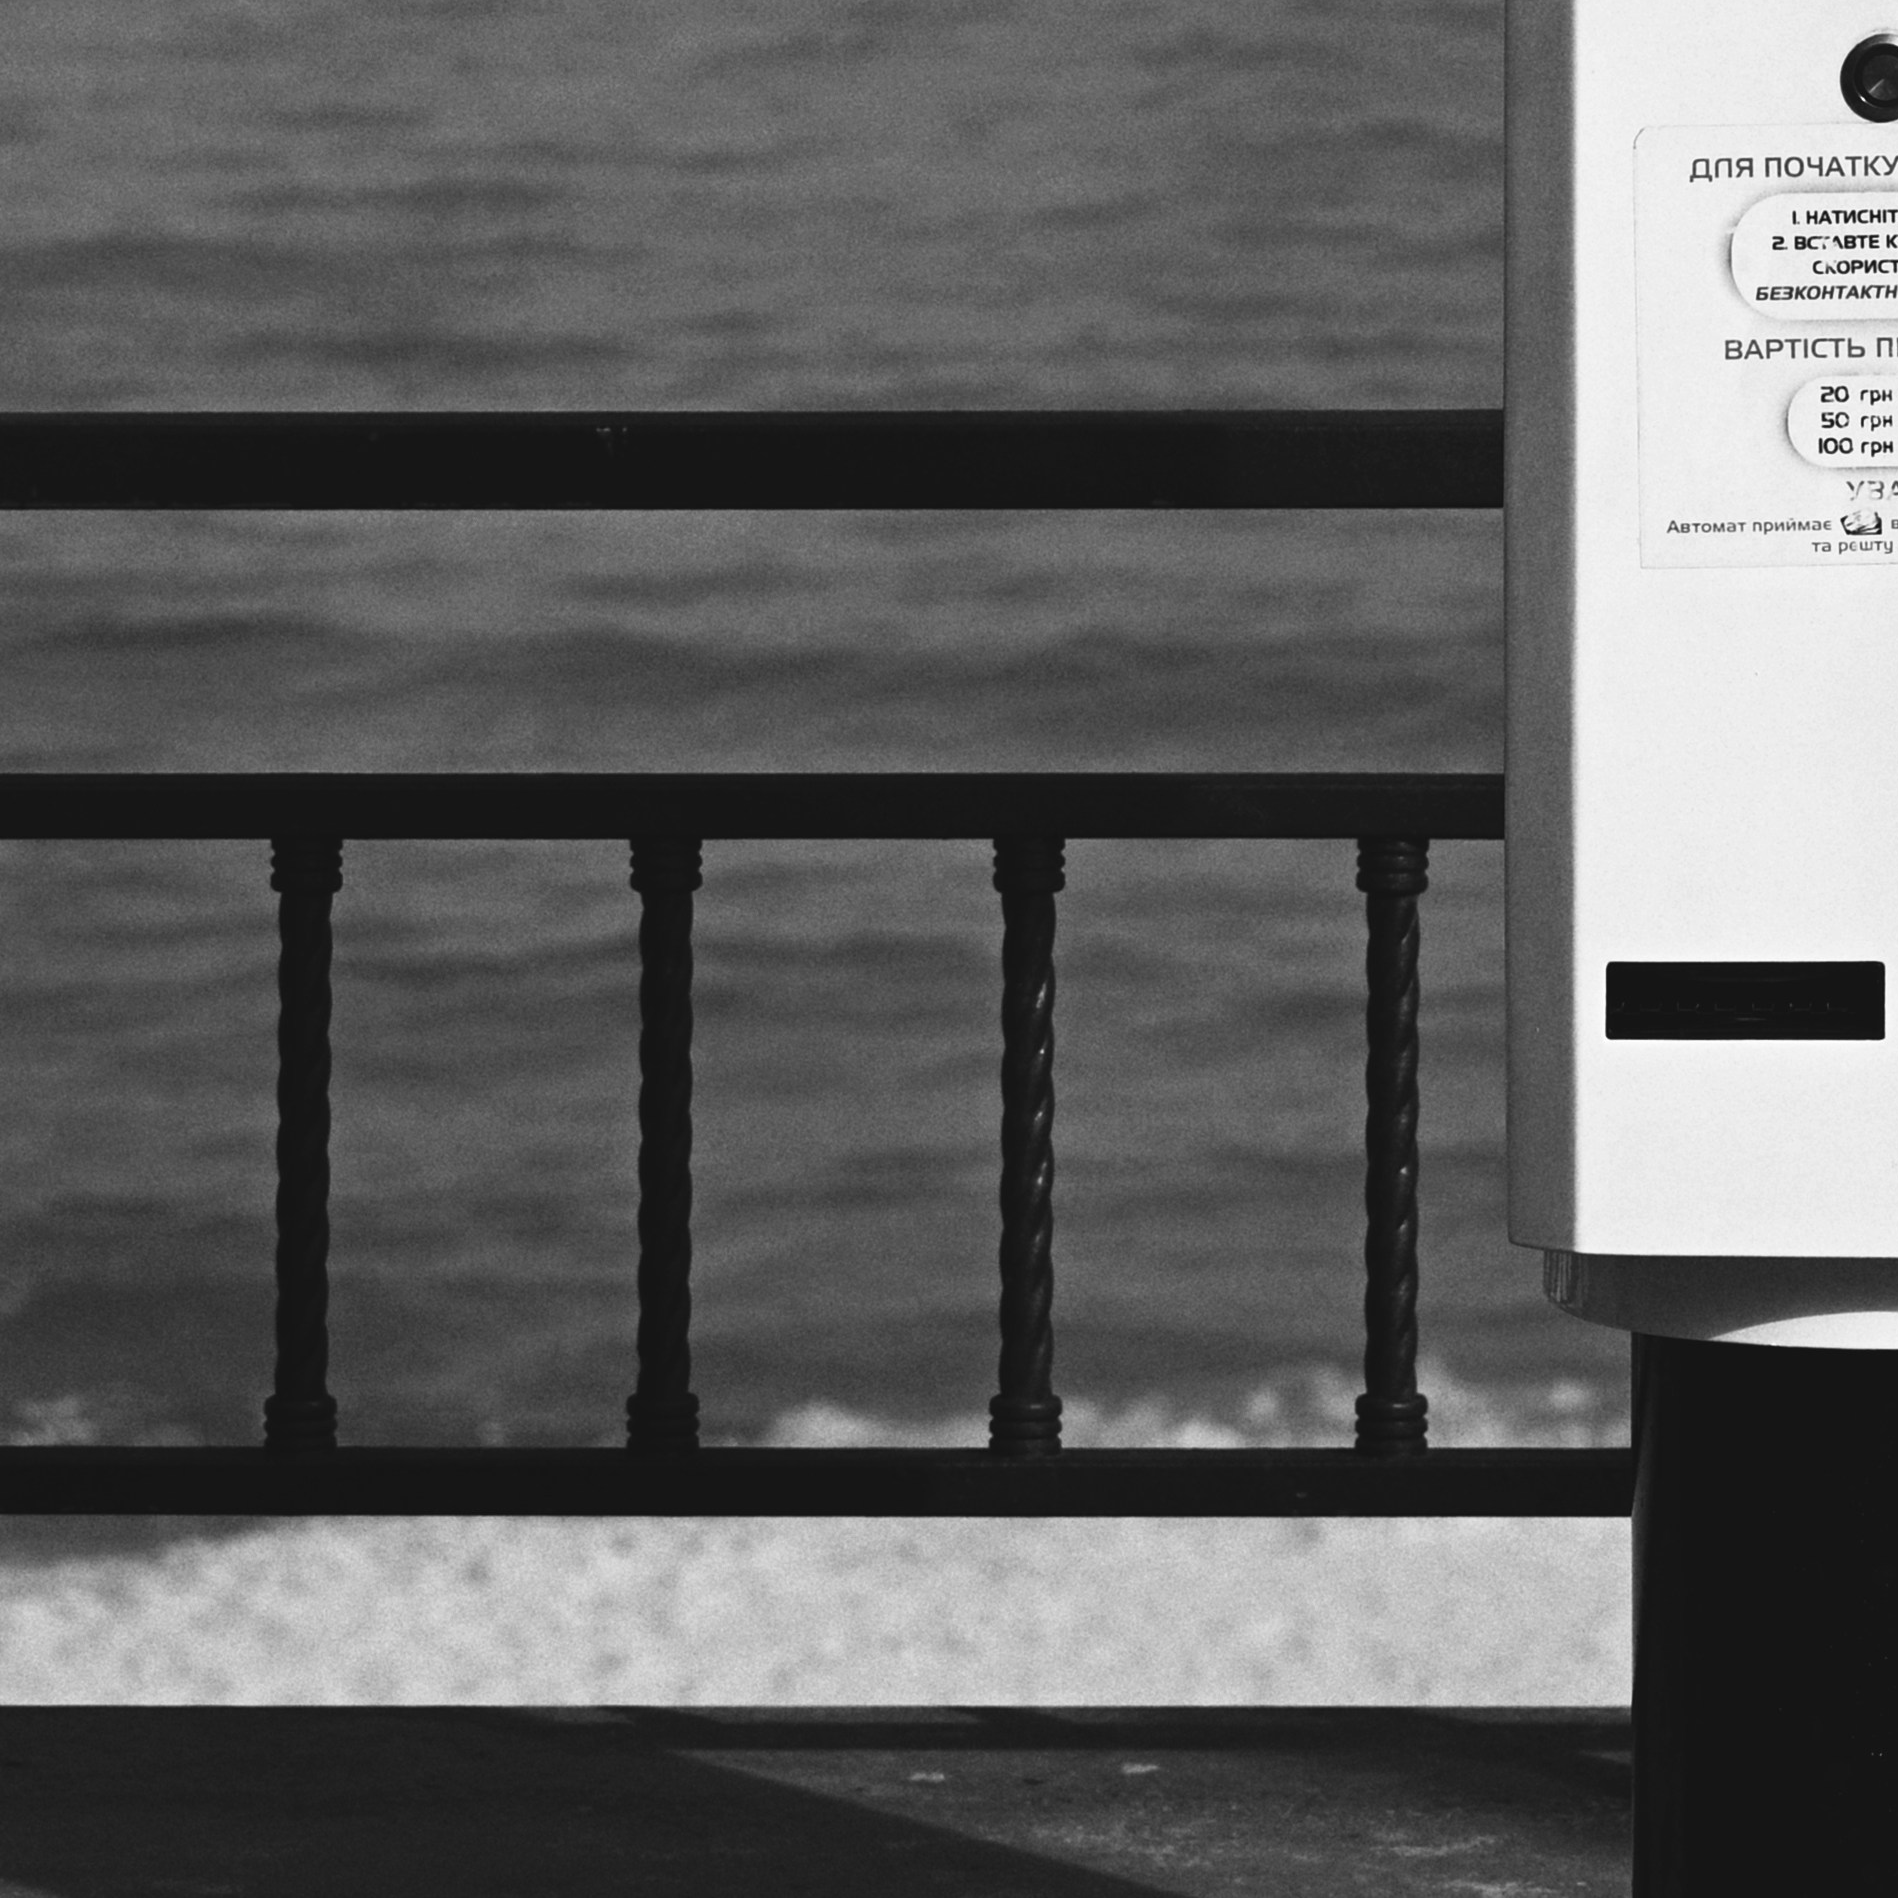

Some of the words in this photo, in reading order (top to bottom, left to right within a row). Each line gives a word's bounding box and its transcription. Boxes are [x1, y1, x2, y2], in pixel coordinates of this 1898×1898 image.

[1689, 157, 1754, 183] ДЛЯ
[1772, 235, 1789, 251] 2.
[1724, 338, 1866, 361] ВАРТІСТЬ
[1820, 385, 1850, 403] 20
[1860, 388, 1893, 406] грн
[1820, 411, 1850, 429] 50
[1860, 414, 1893, 432] грн
[1818, 436, 1854, 455] 100
[1860, 440, 1894, 458] грн
[1666, 520, 1747, 534] Автомат
[1752, 517, 1832, 536] приймає
[1811, 541, 1832, 553] та
[1838, 540, 1894, 555] решту
